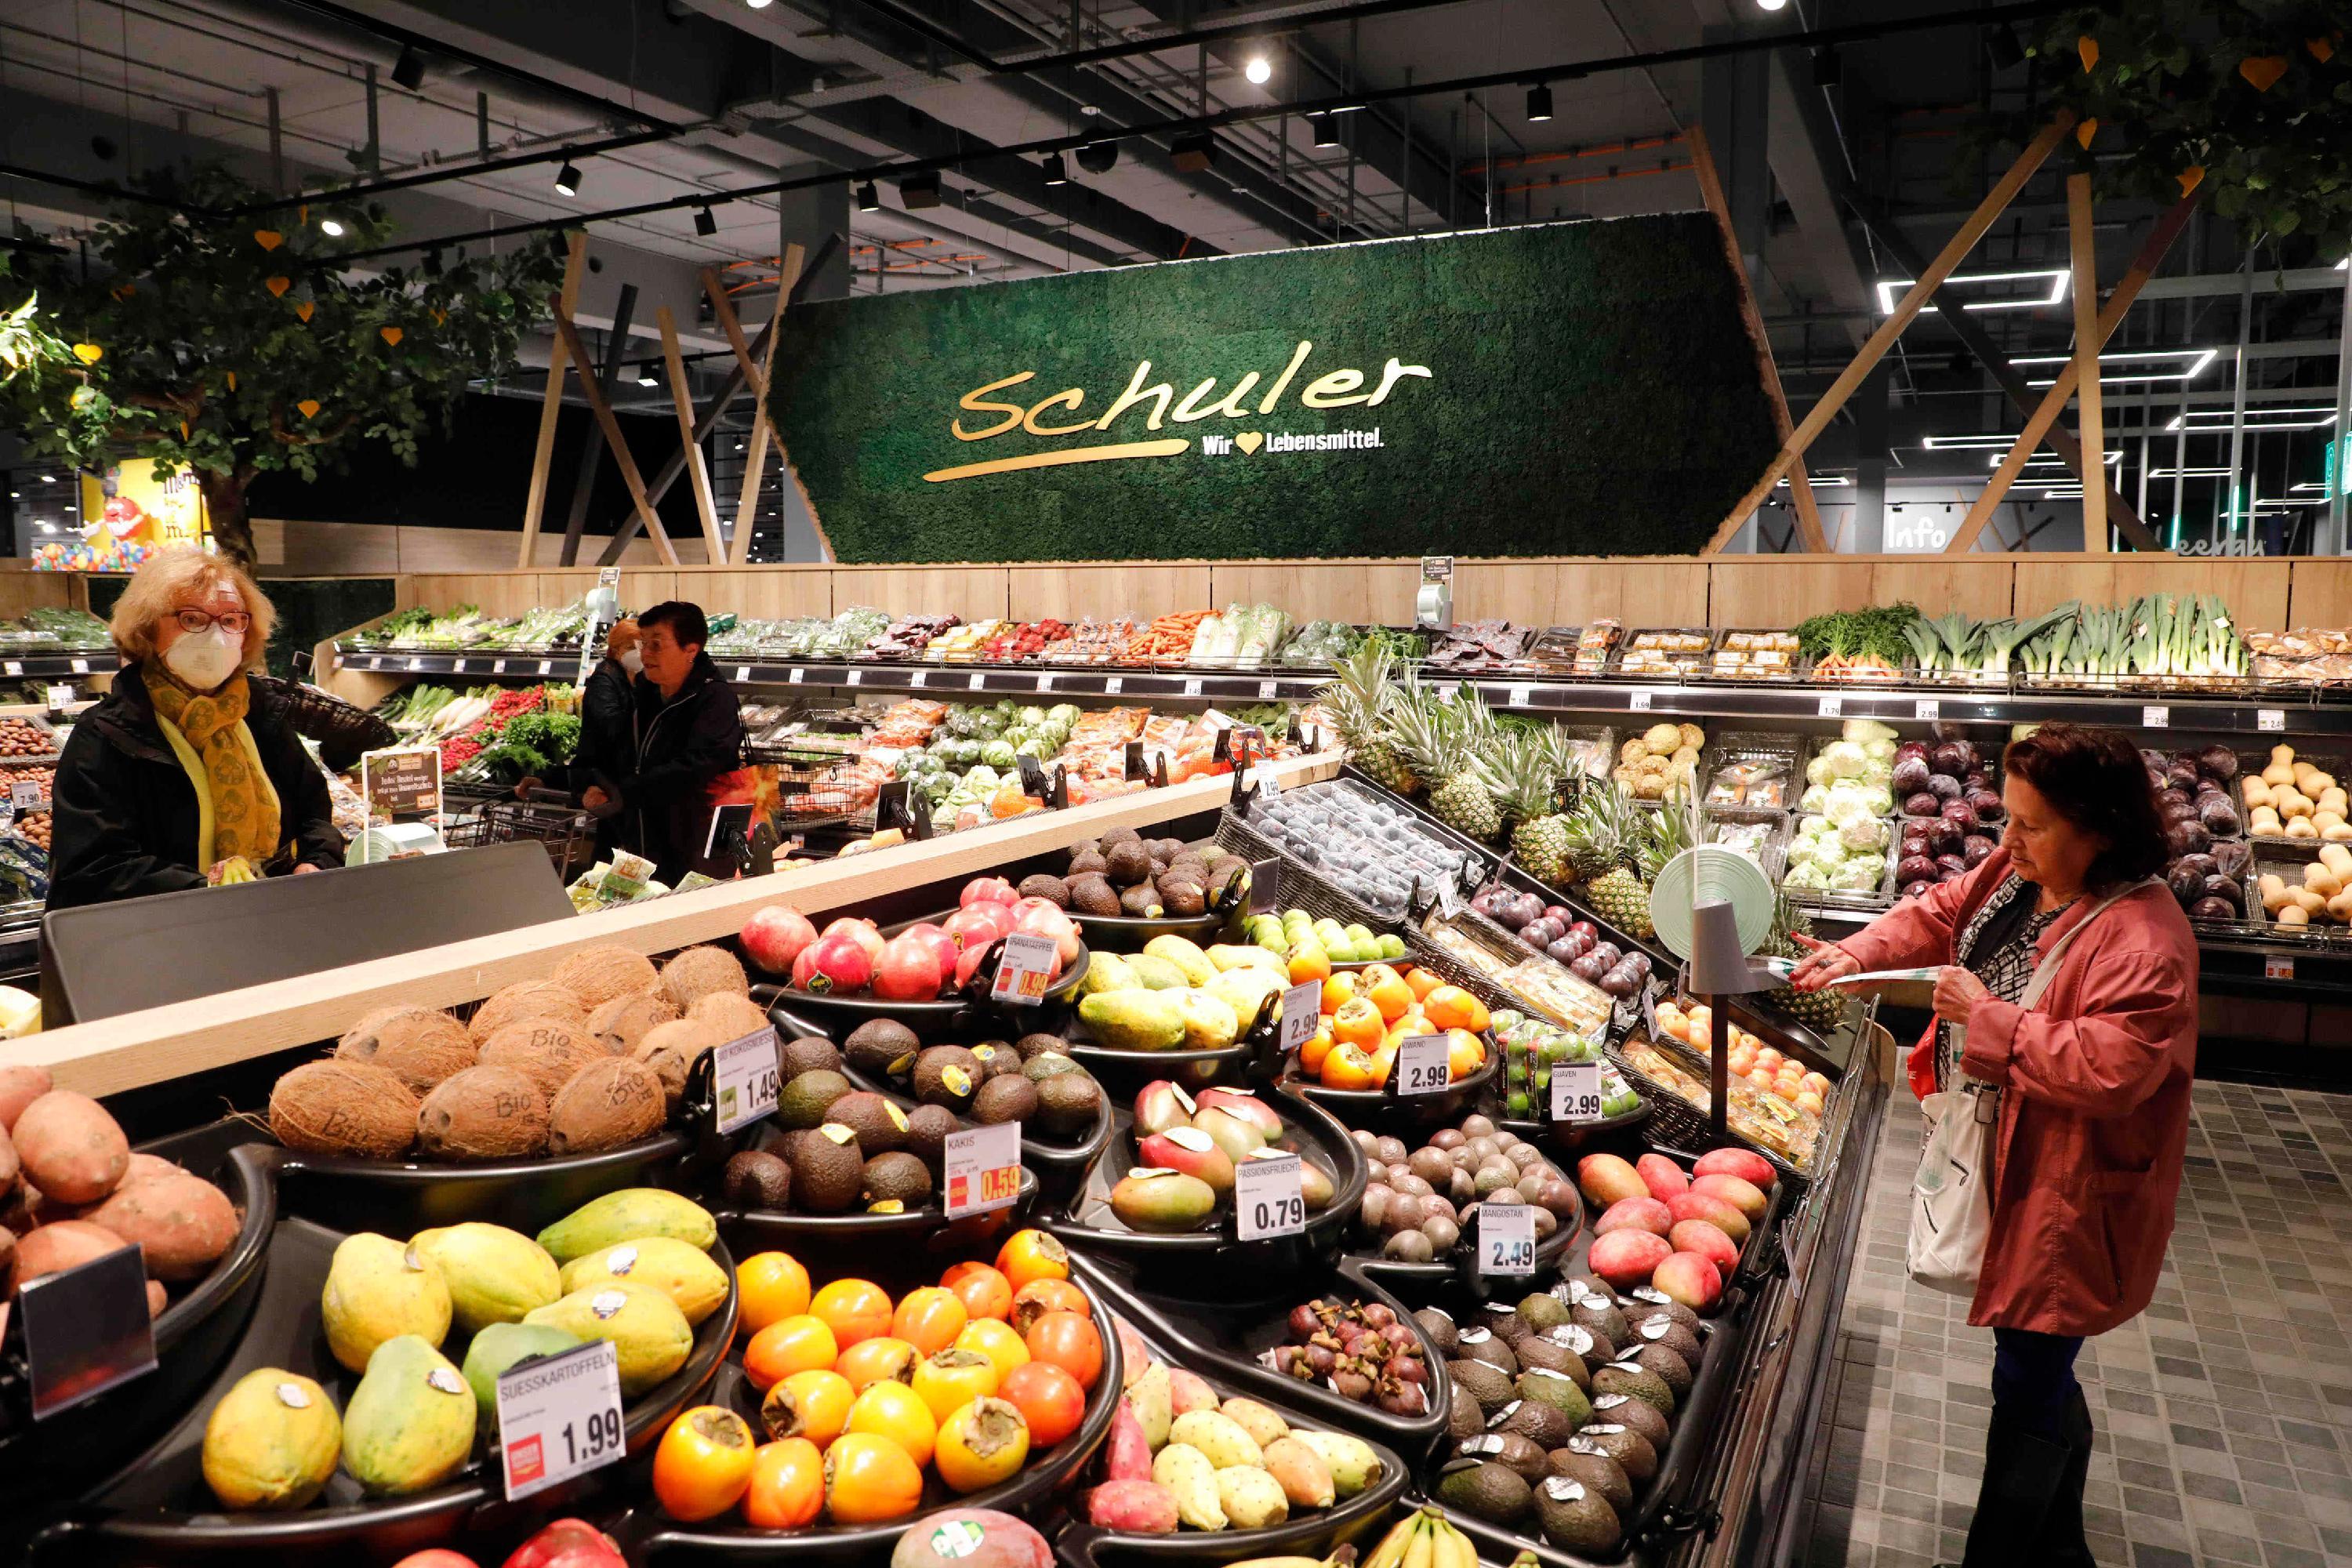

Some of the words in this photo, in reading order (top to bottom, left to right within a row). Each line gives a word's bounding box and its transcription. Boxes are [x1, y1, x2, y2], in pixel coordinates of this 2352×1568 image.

[951, 340, 1433, 441] Schuler
[1202, 435, 1233, 455] Wir
[1265, 427, 1385, 453] Lebensmittel.
[1888, 514, 1946, 548] Info
[2154, 717, 2169, 725] 2.99
[2270, 720, 2285, 728] 2.49
[20, 793, 40, 805] 7.90
[1018, 969, 1049, 997] 0.99
[1290, 1011, 1319, 1040] 2.99
[1401, 1040, 1426, 1049] KIWANO
[1410, 1065, 1447, 1087] 2.99
[747, 1070, 778, 1109] 1.49
[1563, 1094, 1600, 1115] 2.99
[947, 1136, 975, 1150] KAKIS
[981, 1165, 1020, 1202] 0.59
[1238, 1162, 1303, 1179] PASSIONSFRUECHTE
[1254, 1197, 1303, 1230] 0.79
[1481, 1209, 1524, 1218] MANGOSTAN
[1492, 1241, 1533, 1266] 2.49
[500, 1350, 615, 1403] SUESSKARTOFFELN
[561, 1406, 621, 1465] 1.99
